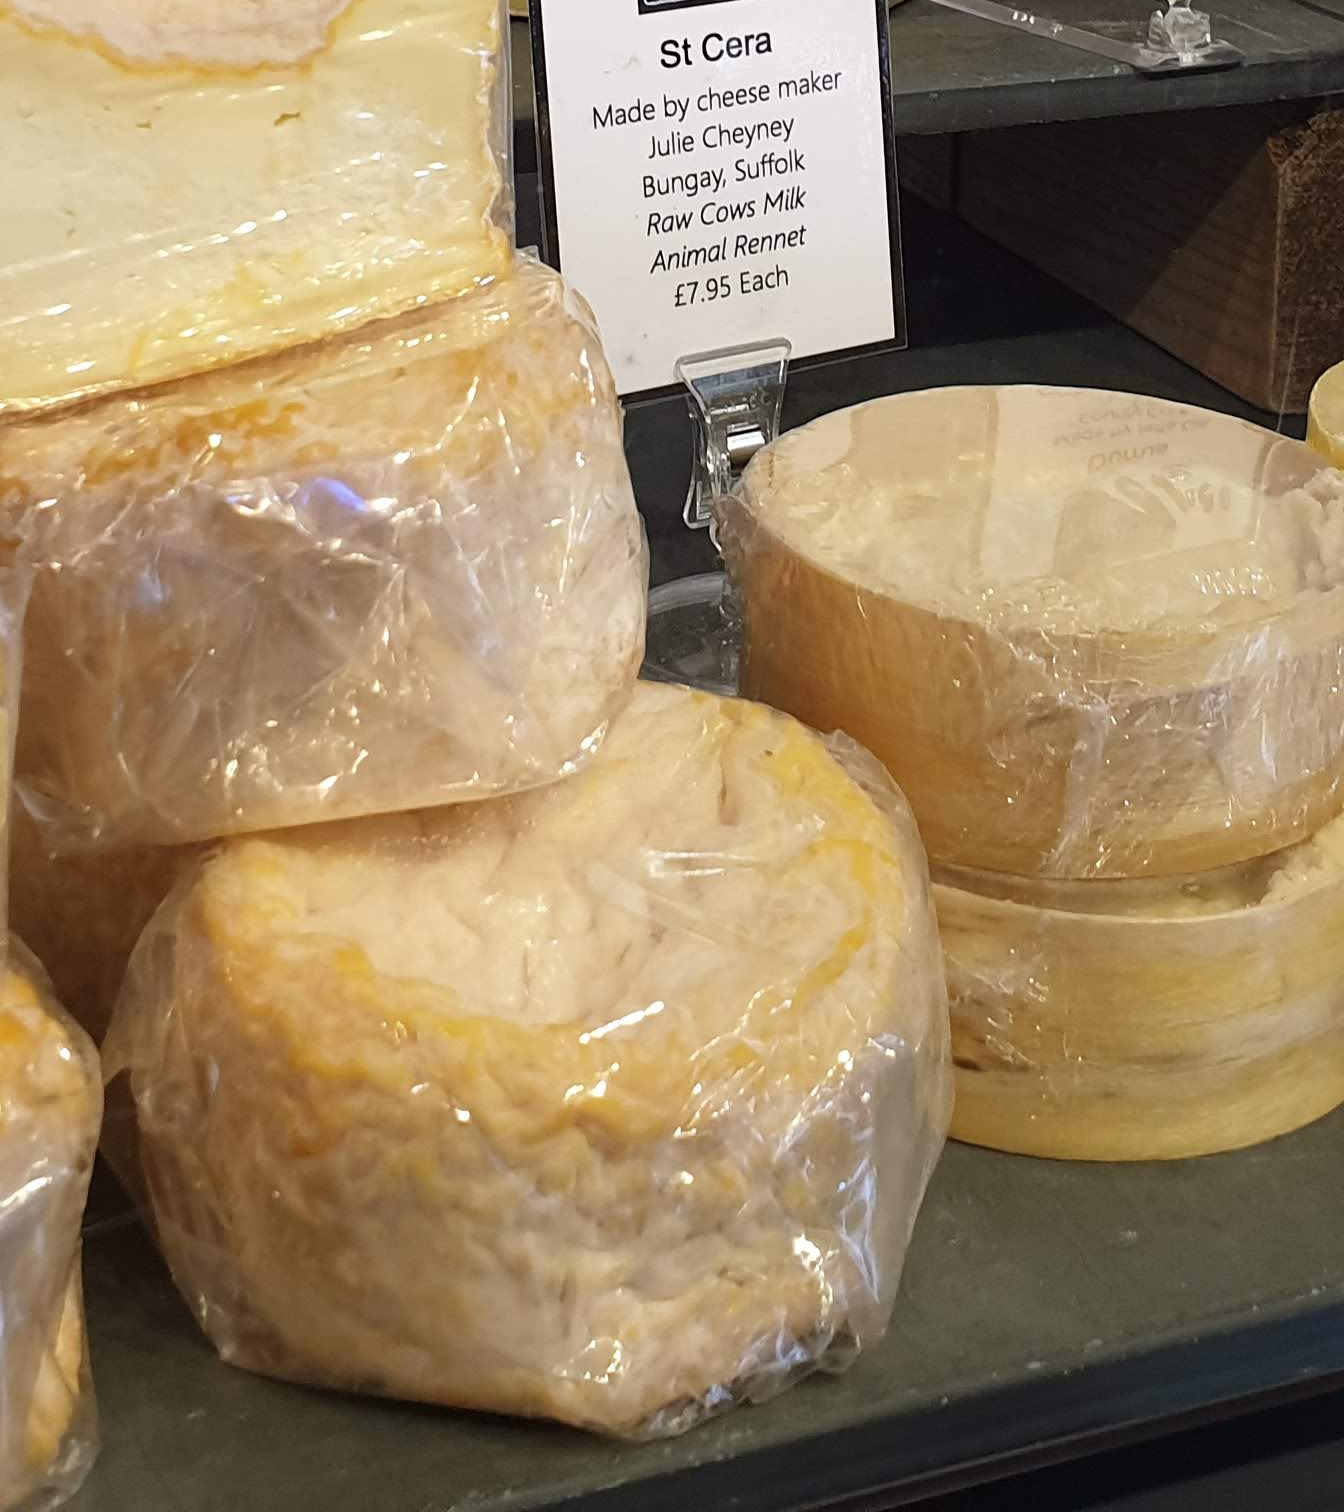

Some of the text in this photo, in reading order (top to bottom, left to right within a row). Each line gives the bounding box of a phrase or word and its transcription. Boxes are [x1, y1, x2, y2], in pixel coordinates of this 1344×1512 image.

[660, 31, 773, 69] St Cera
[592, 69, 842, 130] Made by cheese maker
[648, 117, 795, 160] Julie Cheyney
[642, 148, 806, 199] Bungay, Suffolk
[647, 185, 807, 237] Raw Cows Milk
[650, 224, 807, 274] Animal Rennet
[674, 263, 789, 308] £7.95 Each
